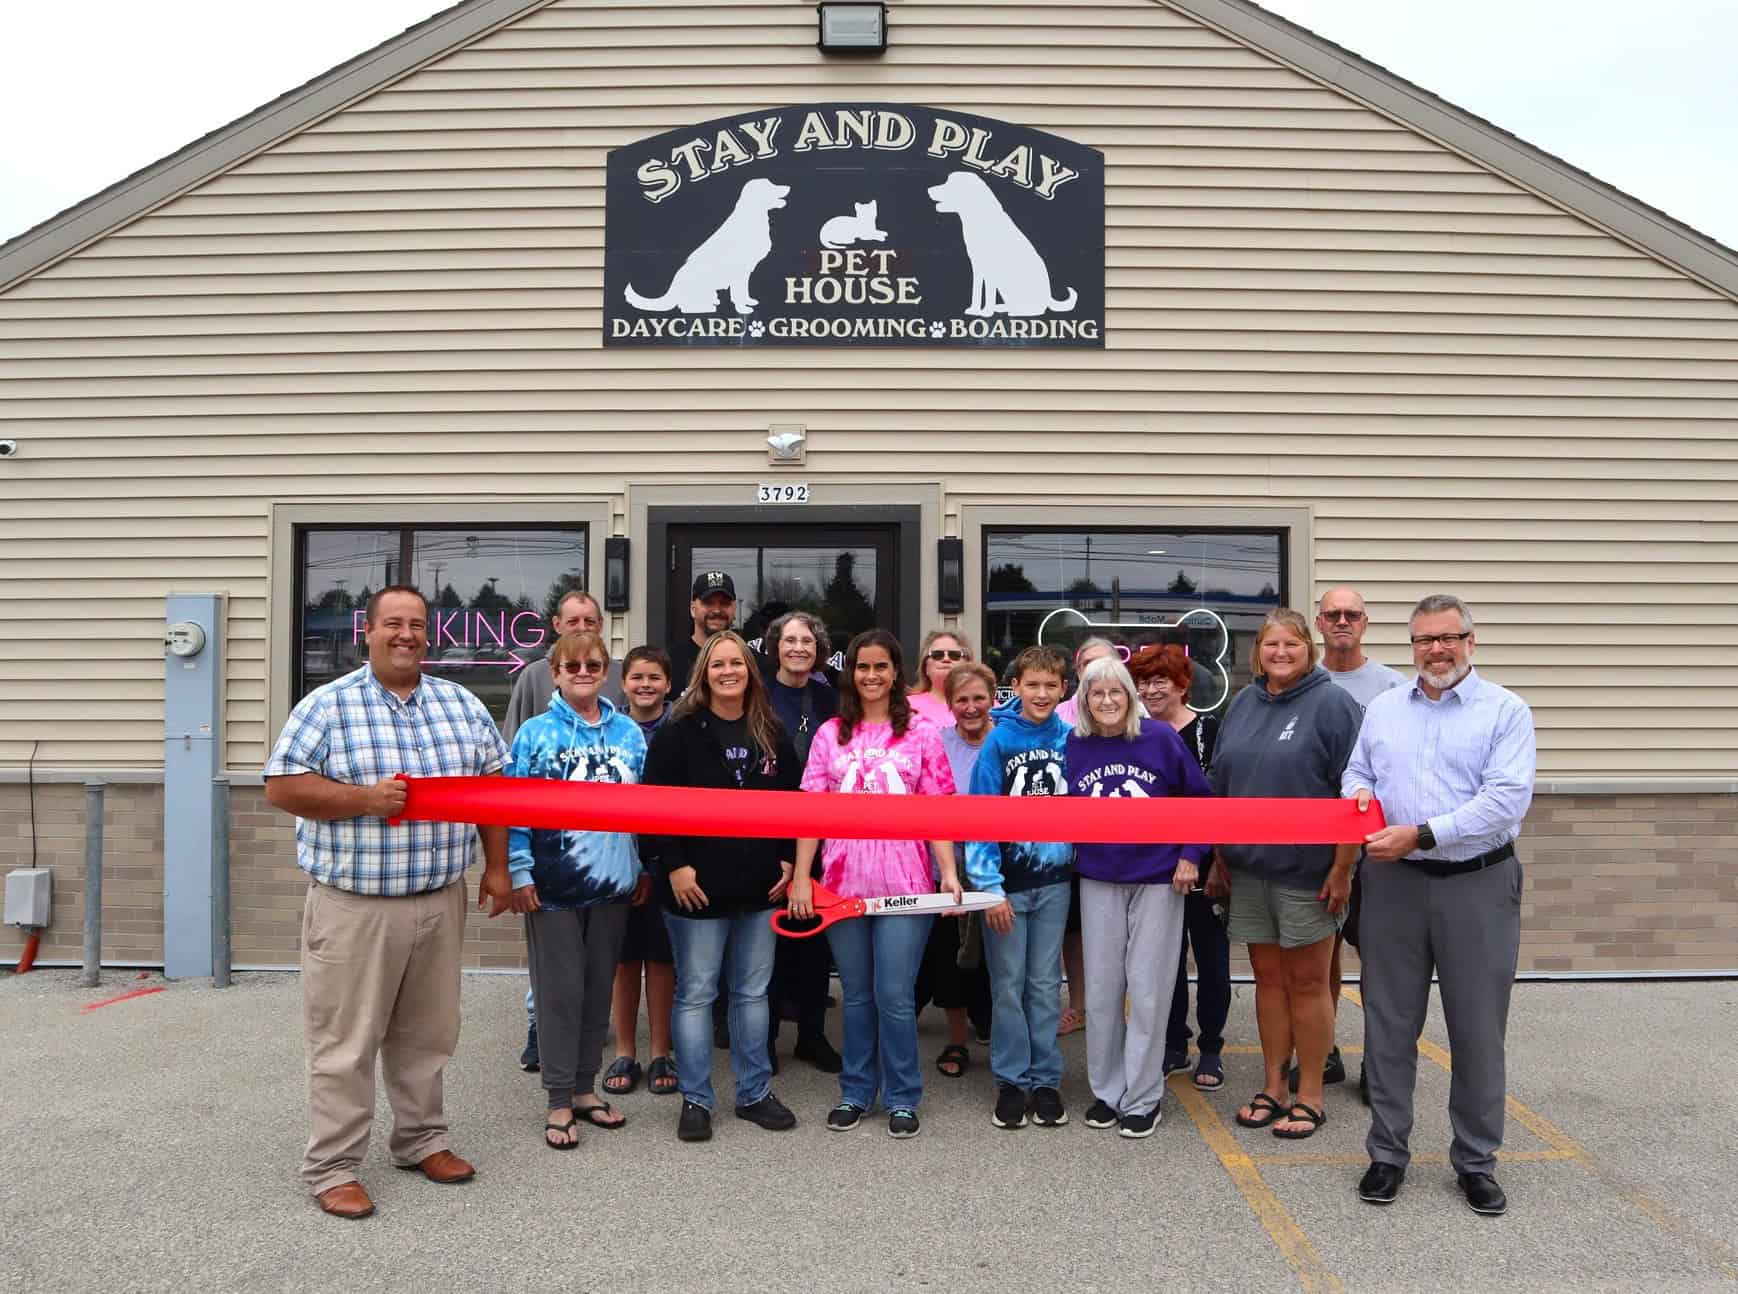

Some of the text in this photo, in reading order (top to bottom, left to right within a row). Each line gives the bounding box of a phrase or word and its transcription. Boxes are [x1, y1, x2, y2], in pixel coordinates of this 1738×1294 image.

[637, 109, 1080, 203] STAY AND PLAY
[819, 249, 897, 275] PET
[784, 277, 922, 304] HOUSE
[611, 318, 1099, 339] DAYCARE GROOMING BOARDING
[761, 486, 806, 501] 3792
[1029, 749, 1049, 761] AND
[1078, 763, 1157, 792] STAY AND PLAY
[884, 896, 918, 908] Keller
